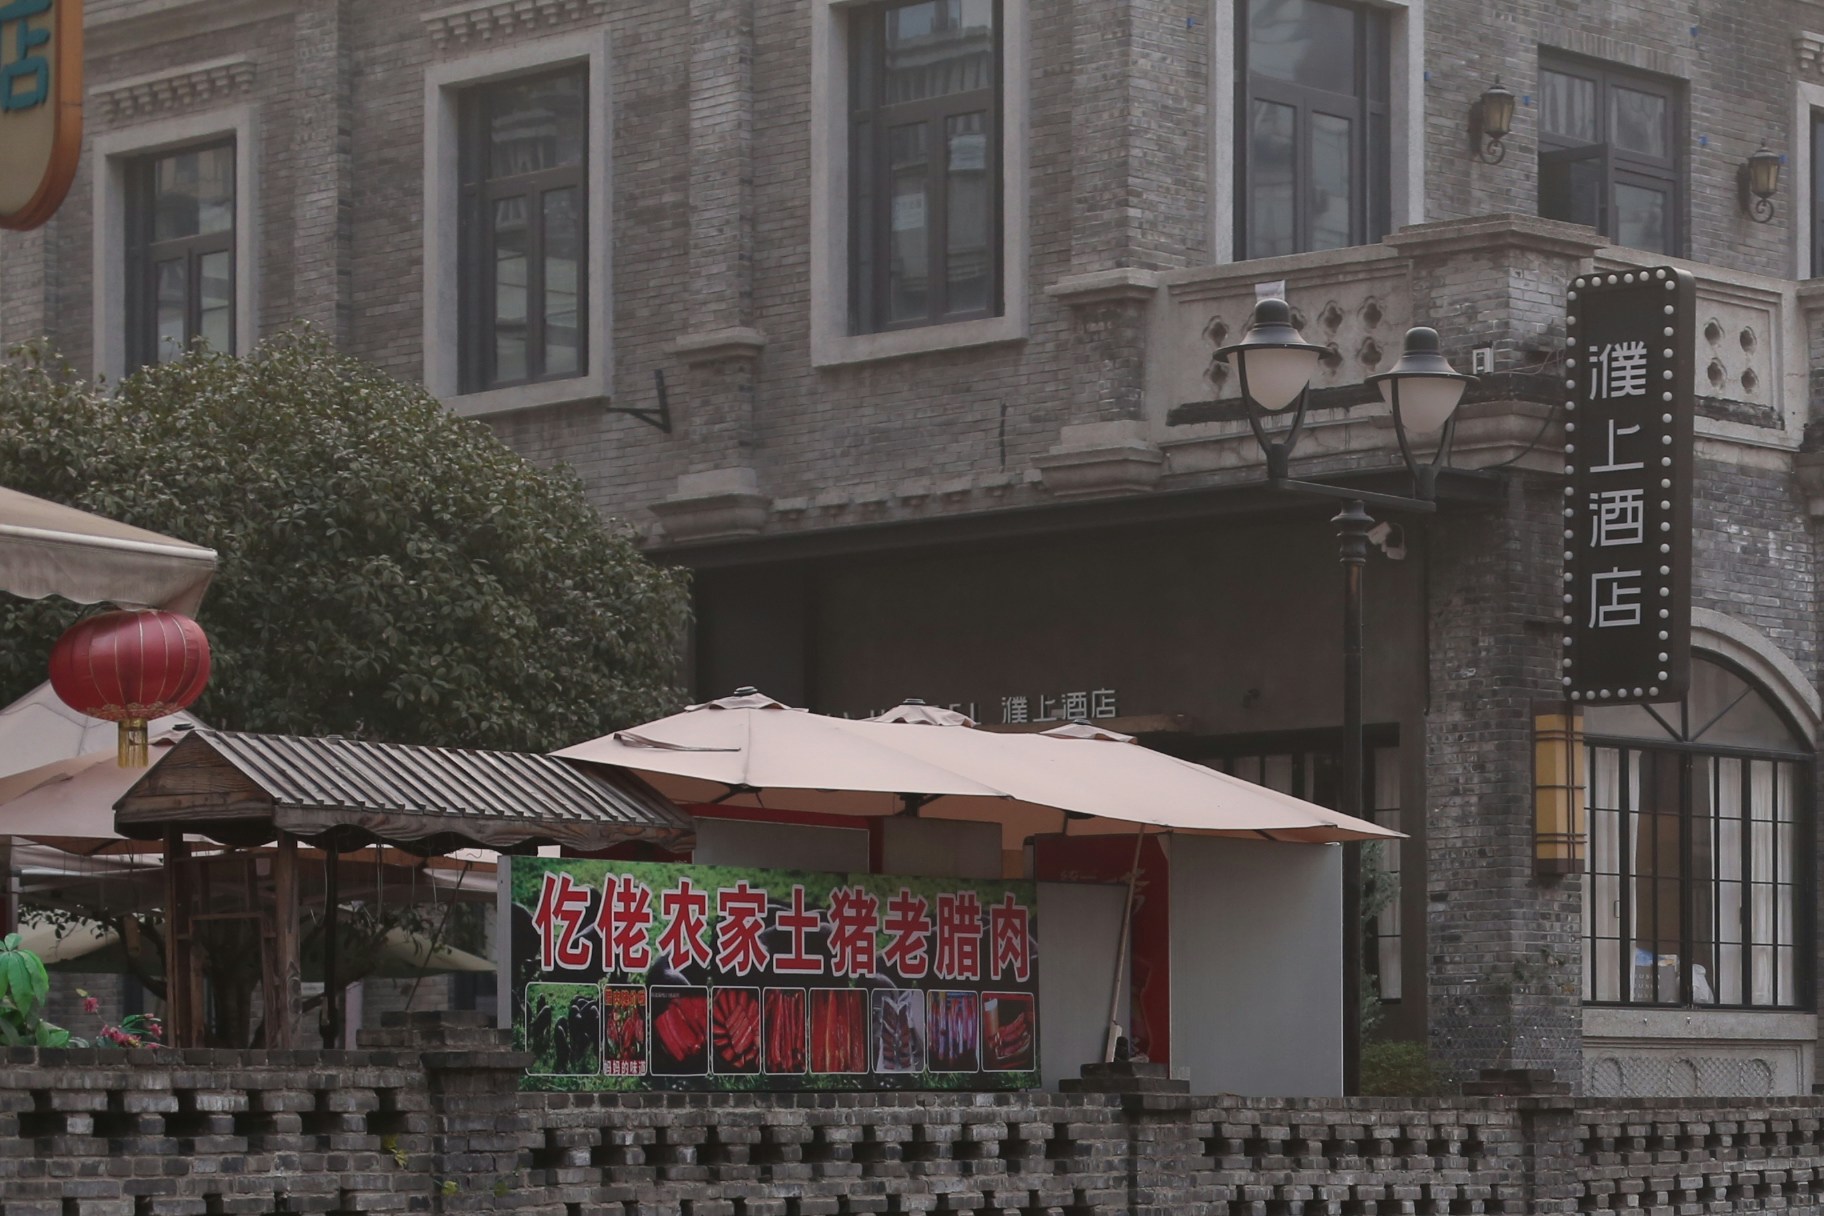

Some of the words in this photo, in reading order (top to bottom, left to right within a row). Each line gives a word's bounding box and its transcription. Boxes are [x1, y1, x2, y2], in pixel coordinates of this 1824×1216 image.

[1588, 341, 1648, 629] 濮上酒店
[1001, 688, 1116, 724] 濮上酒店
[533, 871, 1029, 982] 仡佬农家土猪老腊肉
